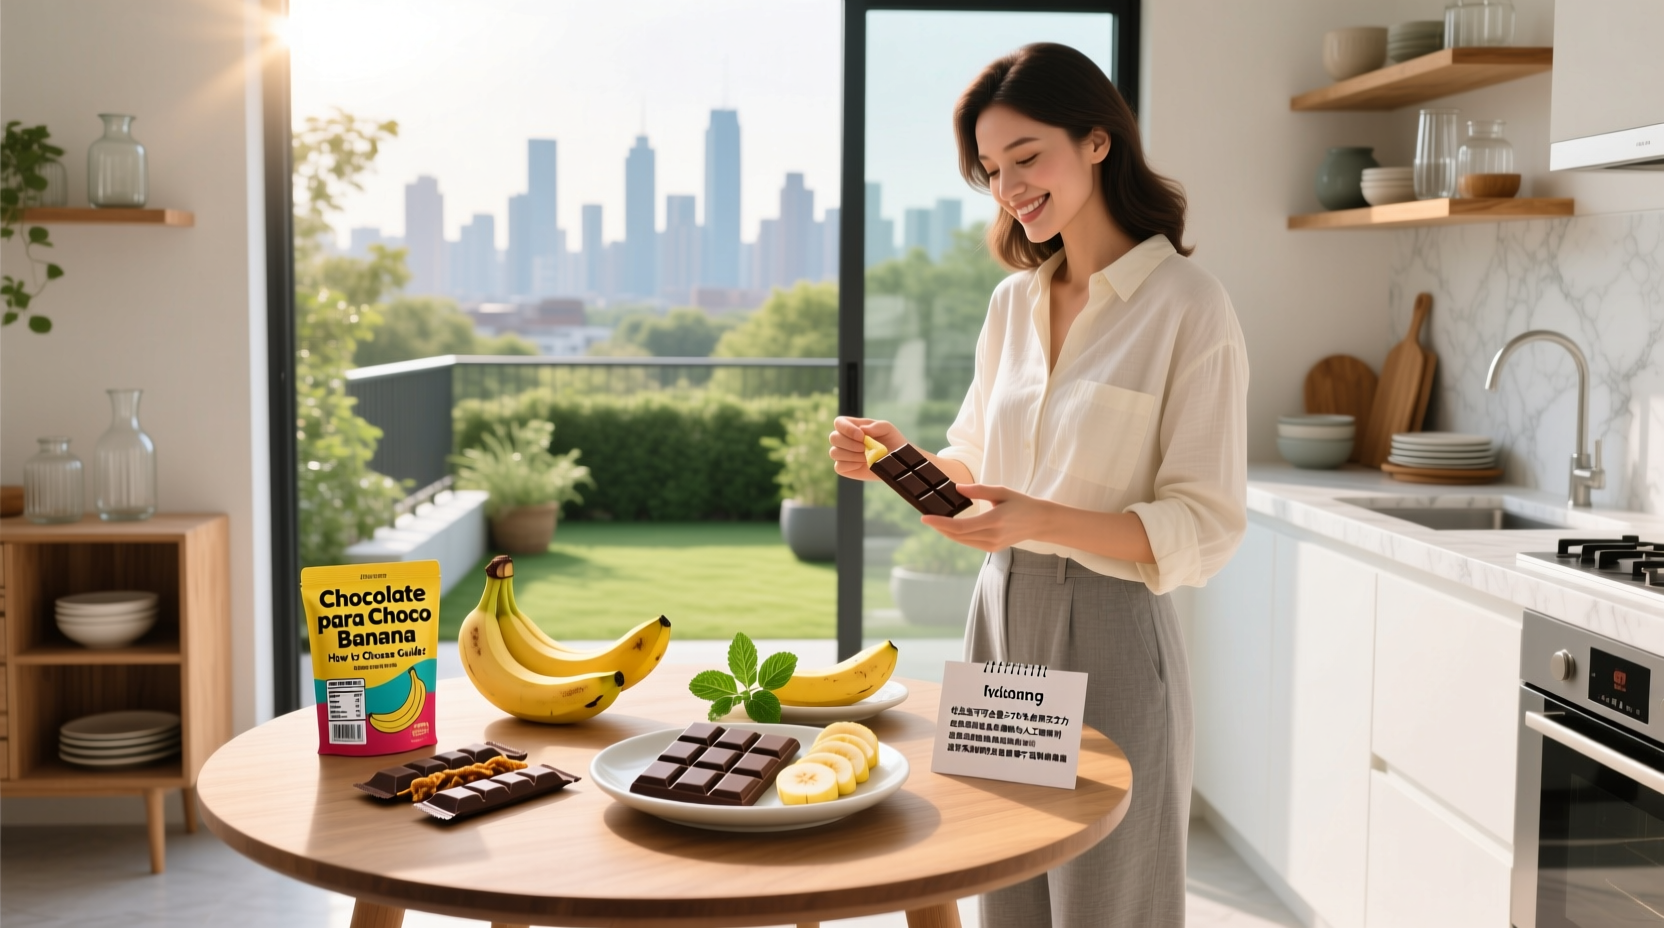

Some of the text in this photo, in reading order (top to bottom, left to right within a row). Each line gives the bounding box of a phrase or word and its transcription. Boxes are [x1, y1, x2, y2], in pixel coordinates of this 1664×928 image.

[319, 585, 426, 608] Chocolate
[318, 607, 432, 634] para Choco
[338, 629, 416, 648] Banana
[328, 653, 348, 663] How
